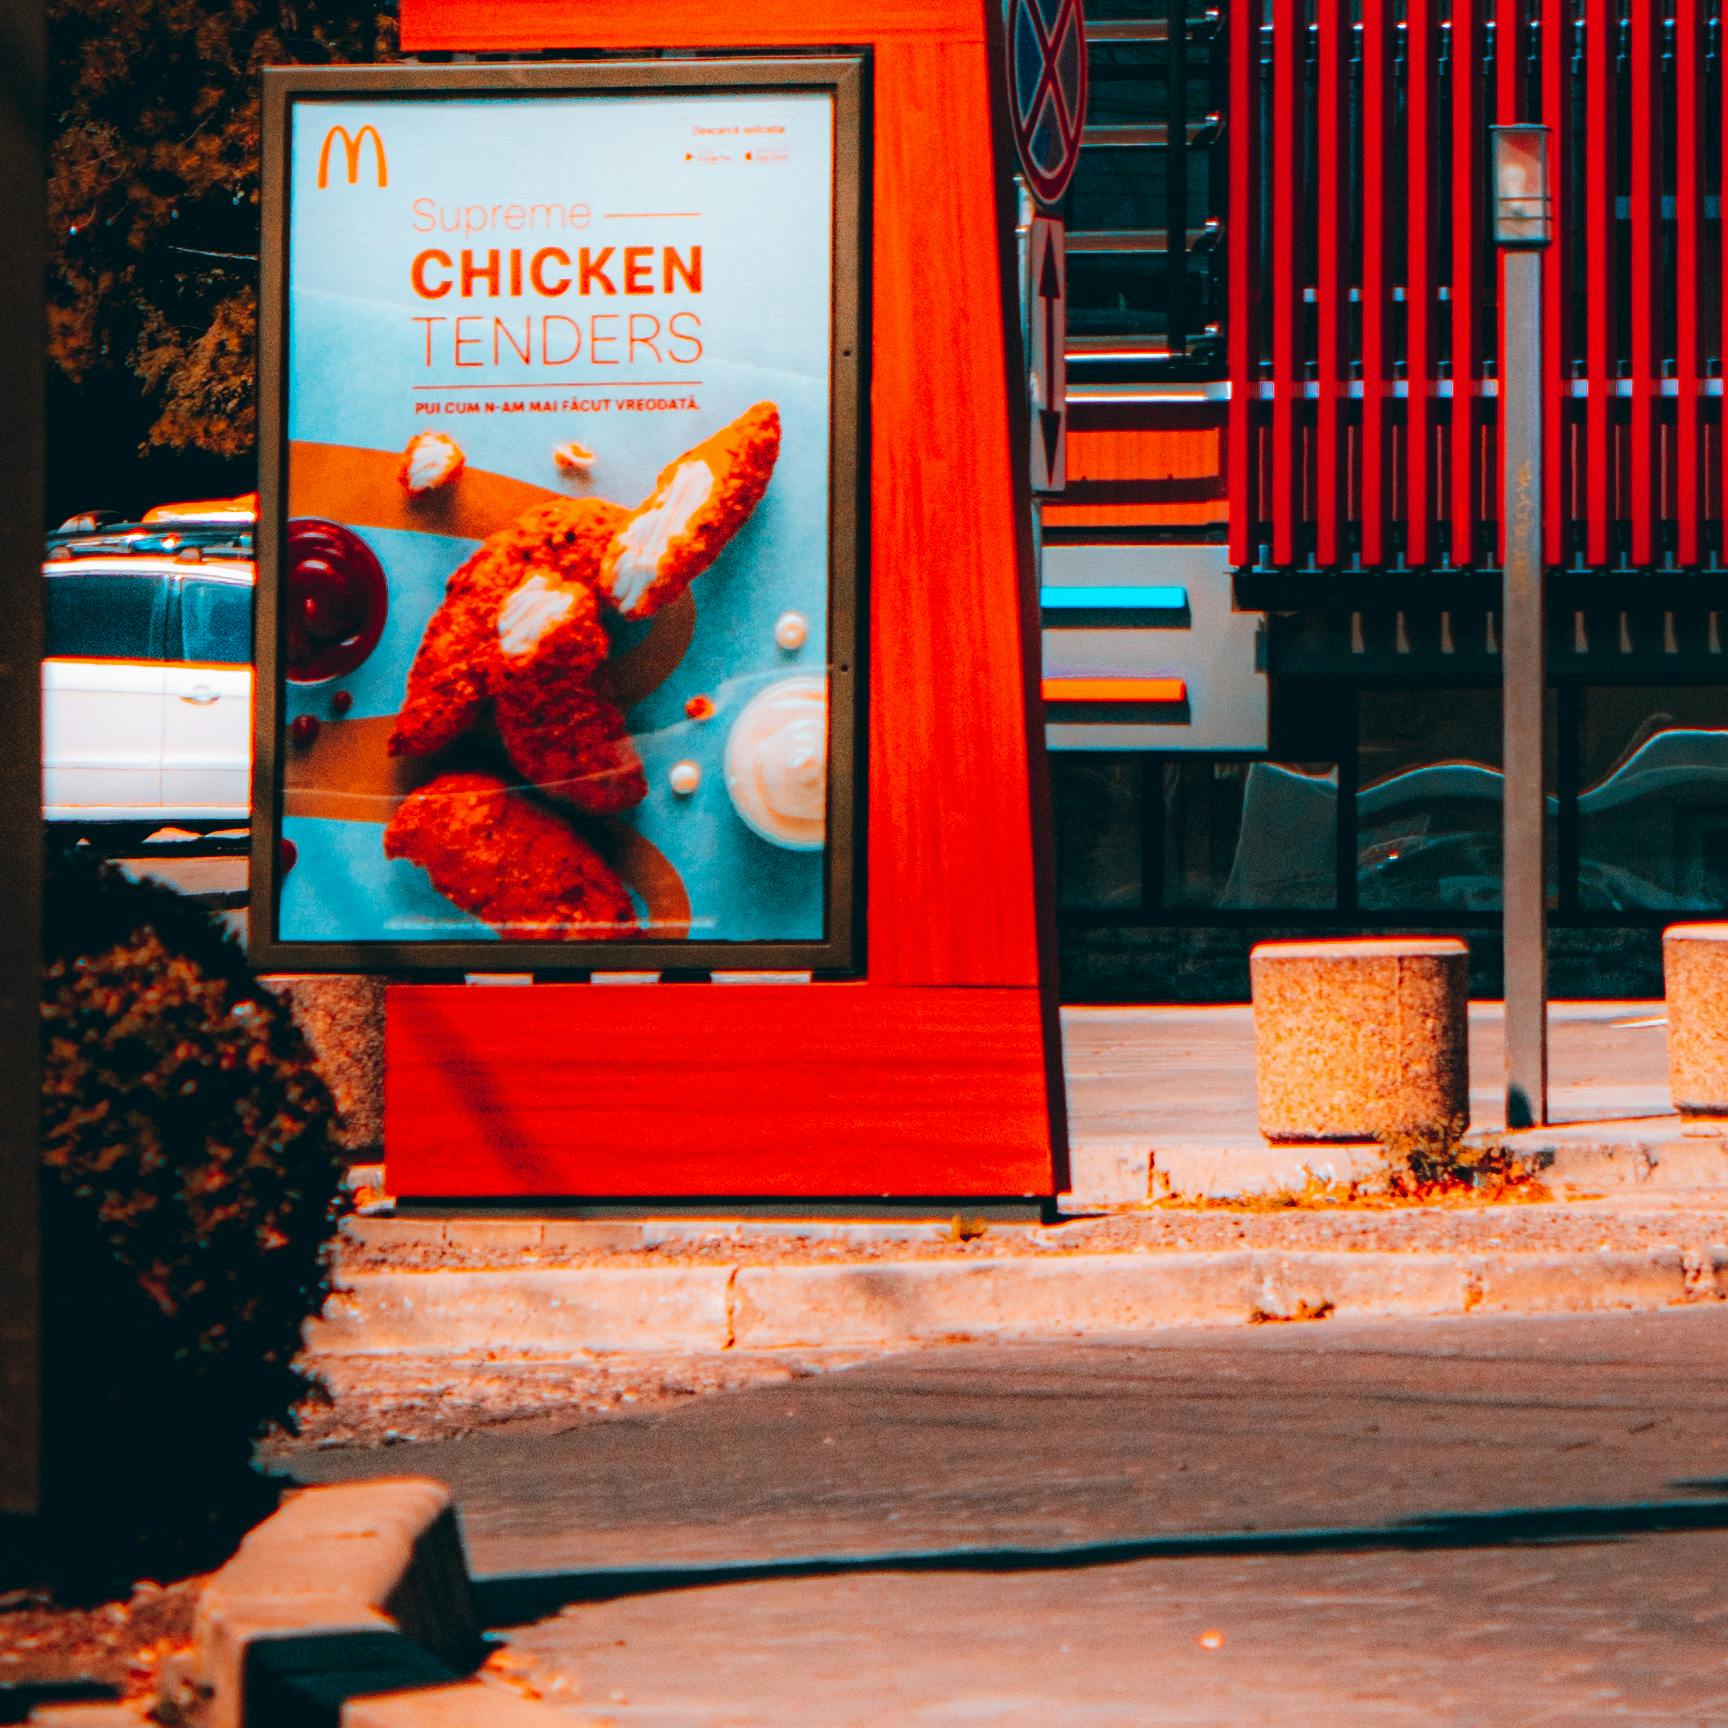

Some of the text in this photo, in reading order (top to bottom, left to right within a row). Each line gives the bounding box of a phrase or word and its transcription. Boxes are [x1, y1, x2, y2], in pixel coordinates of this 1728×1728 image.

[411, 197, 592, 240] Supreme
[410, 245, 703, 300] CHICKEN
[411, 311, 704, 368] TENDERS
[415, 402, 441, 415] PUI
[444, 401, 481, 414] CUM
[484, 401, 526, 414] N-AM
[529, 400, 559, 413] MAI
